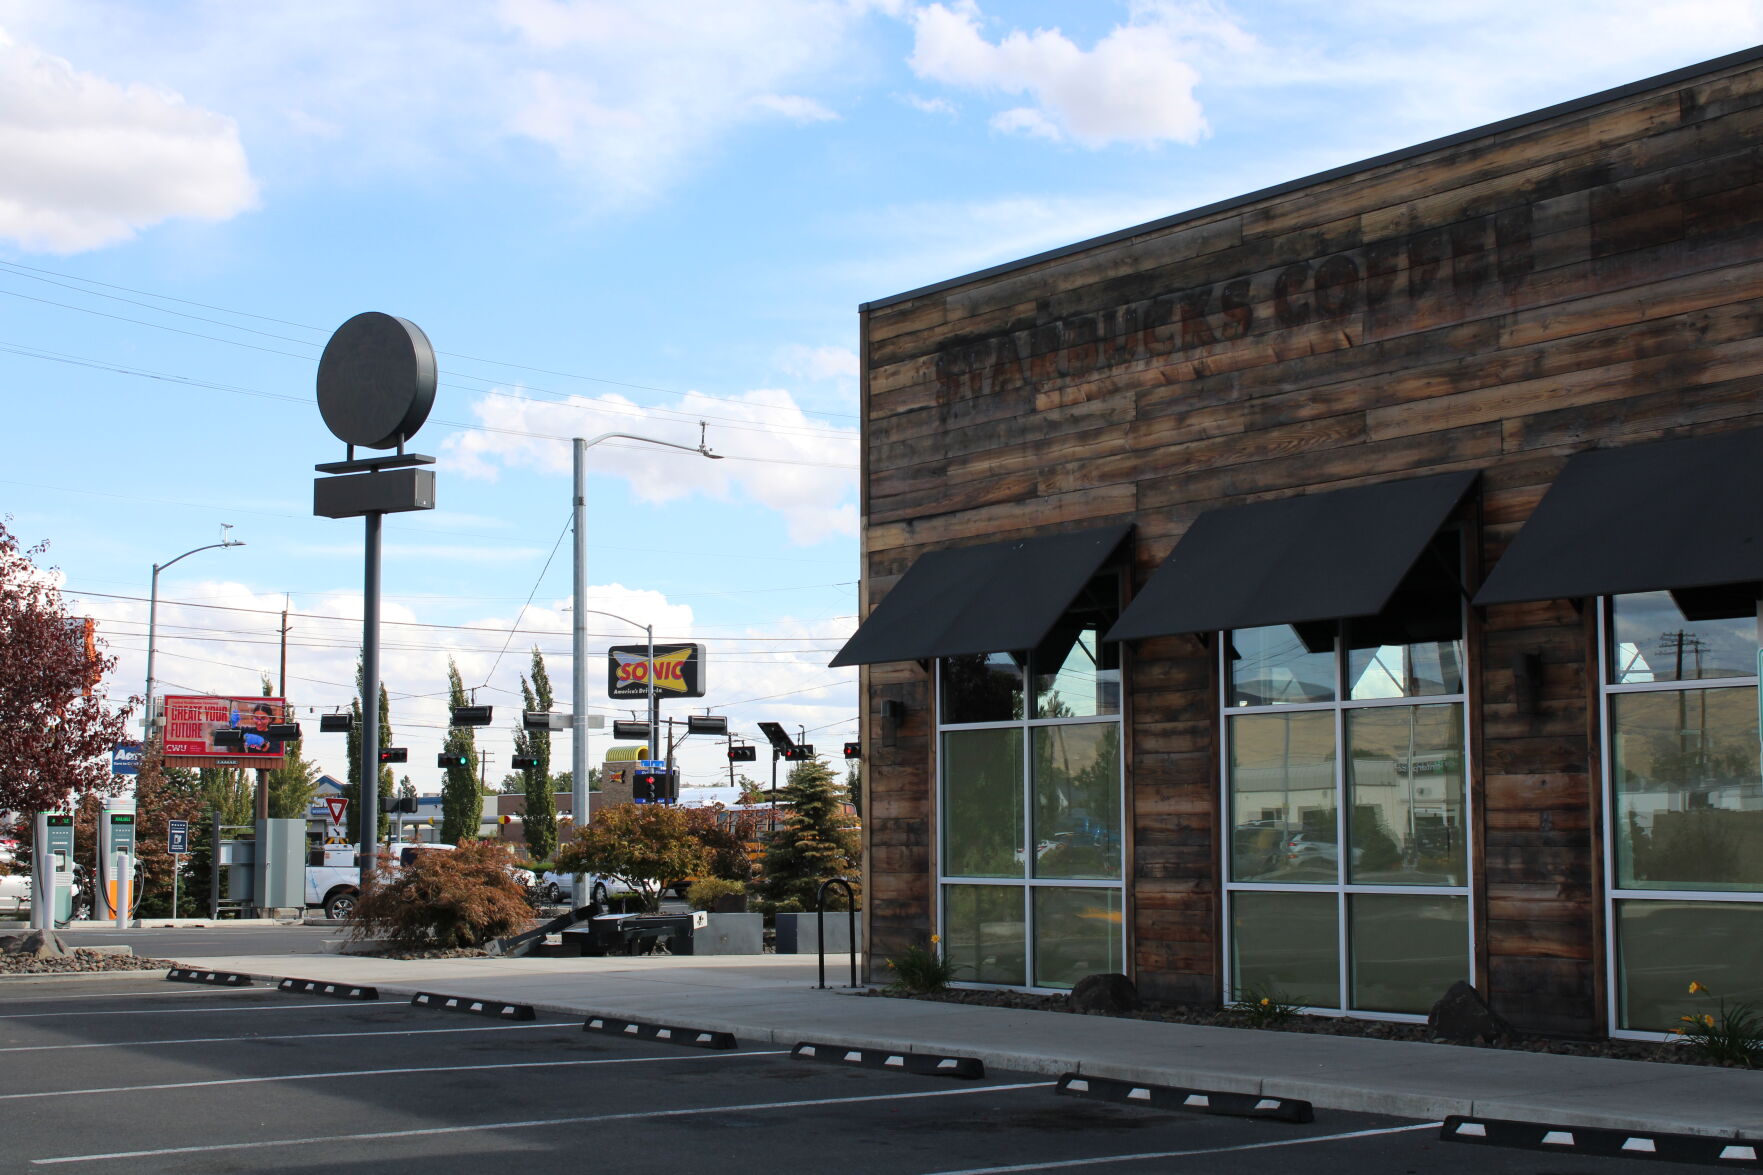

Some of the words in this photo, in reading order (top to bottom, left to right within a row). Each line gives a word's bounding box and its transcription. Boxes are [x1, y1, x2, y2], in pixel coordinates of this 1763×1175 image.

[618, 660, 686, 681] SONIC
[171, 704, 203, 722] CREATE
[205, 705, 229, 722] YOUR
[170, 722, 203, 739] FUTURE
[166, 744, 188, 752] CWU
